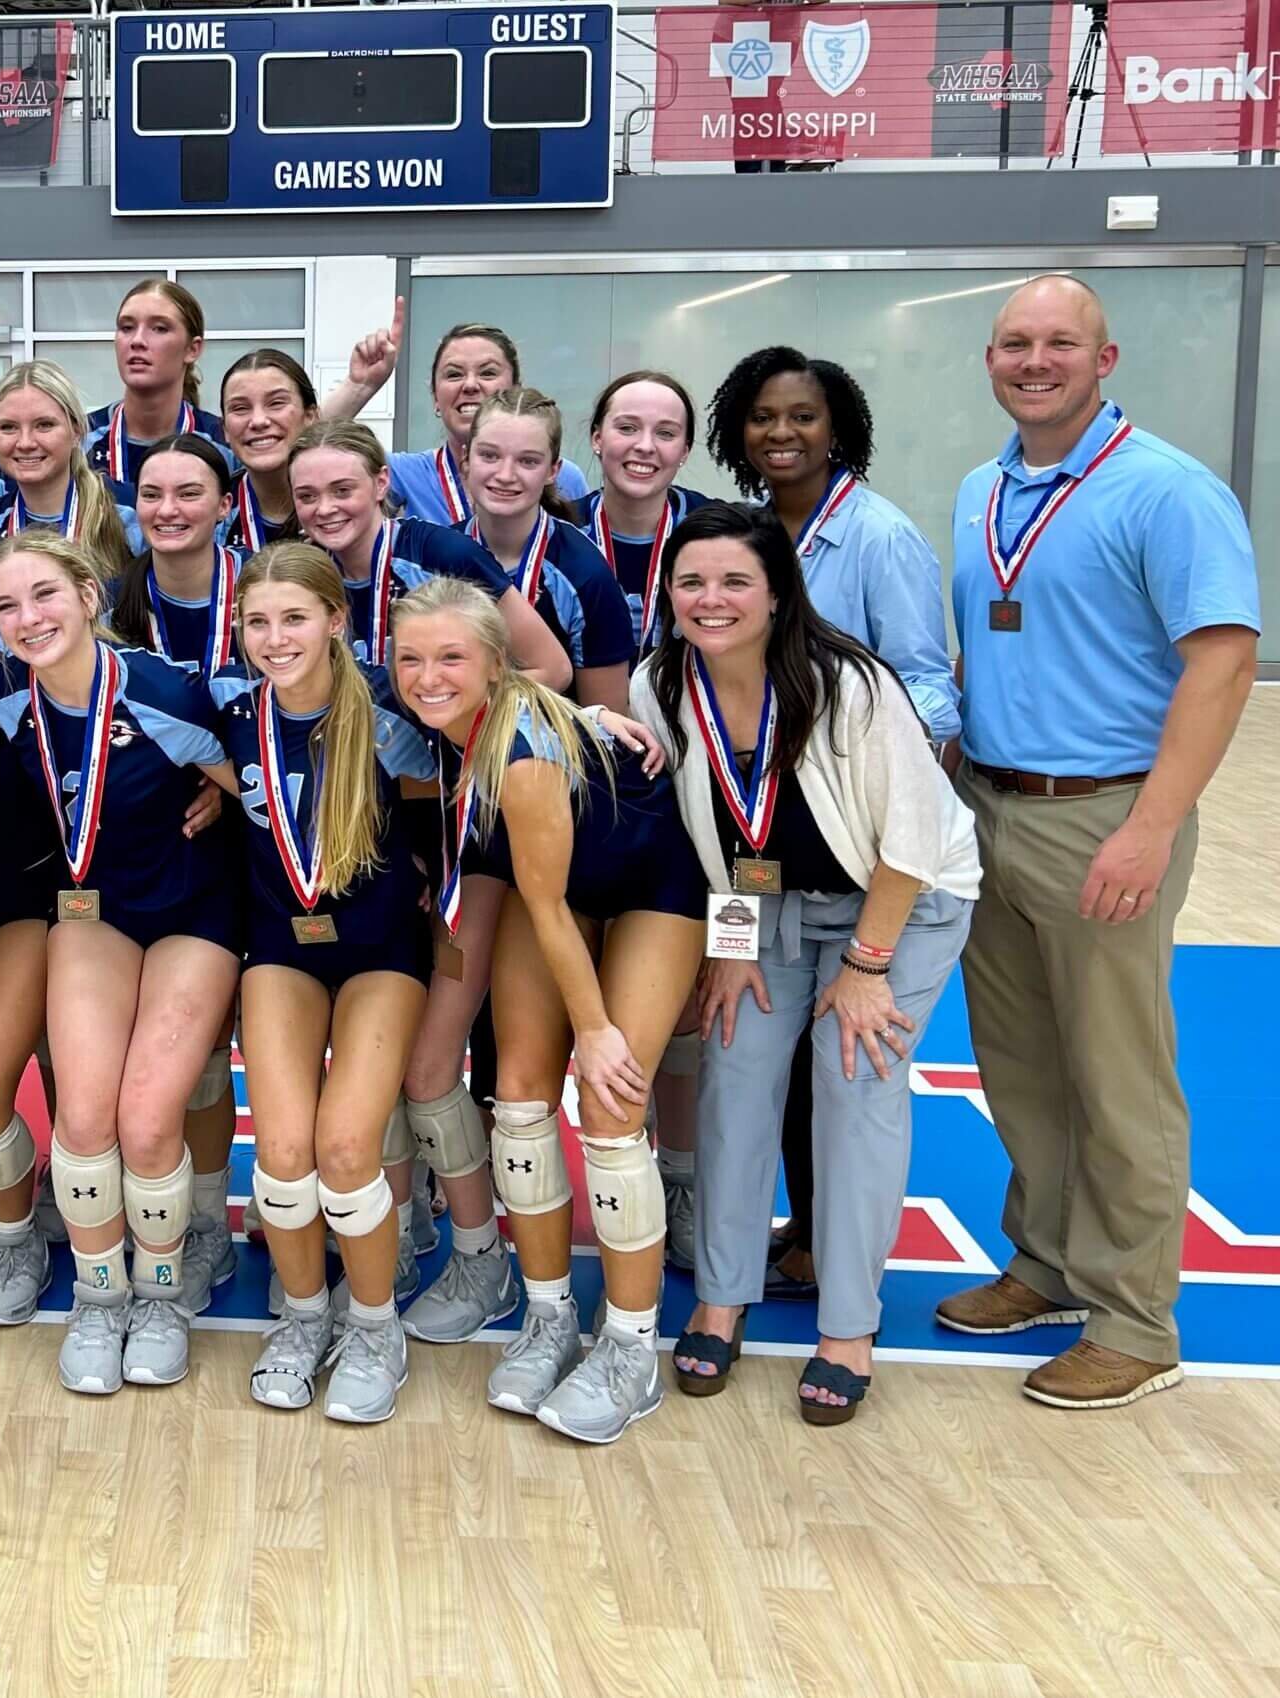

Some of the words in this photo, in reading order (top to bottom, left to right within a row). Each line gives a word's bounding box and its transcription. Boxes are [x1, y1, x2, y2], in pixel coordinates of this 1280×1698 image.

[146, 22, 226, 50] HOME
[491, 13, 586, 42] GUEST
[331, 49, 390, 57] DAKTRONICS
[940, 63, 1041, 91] MHSAA
[935, 93, 967, 103] STATE
[970, 92, 1043, 102] CHAMPIONSHIPS
[701, 111, 876, 139] MISSISSIPPI
[274, 160, 371, 190] GAMES
[376, 158, 443, 188] WON
